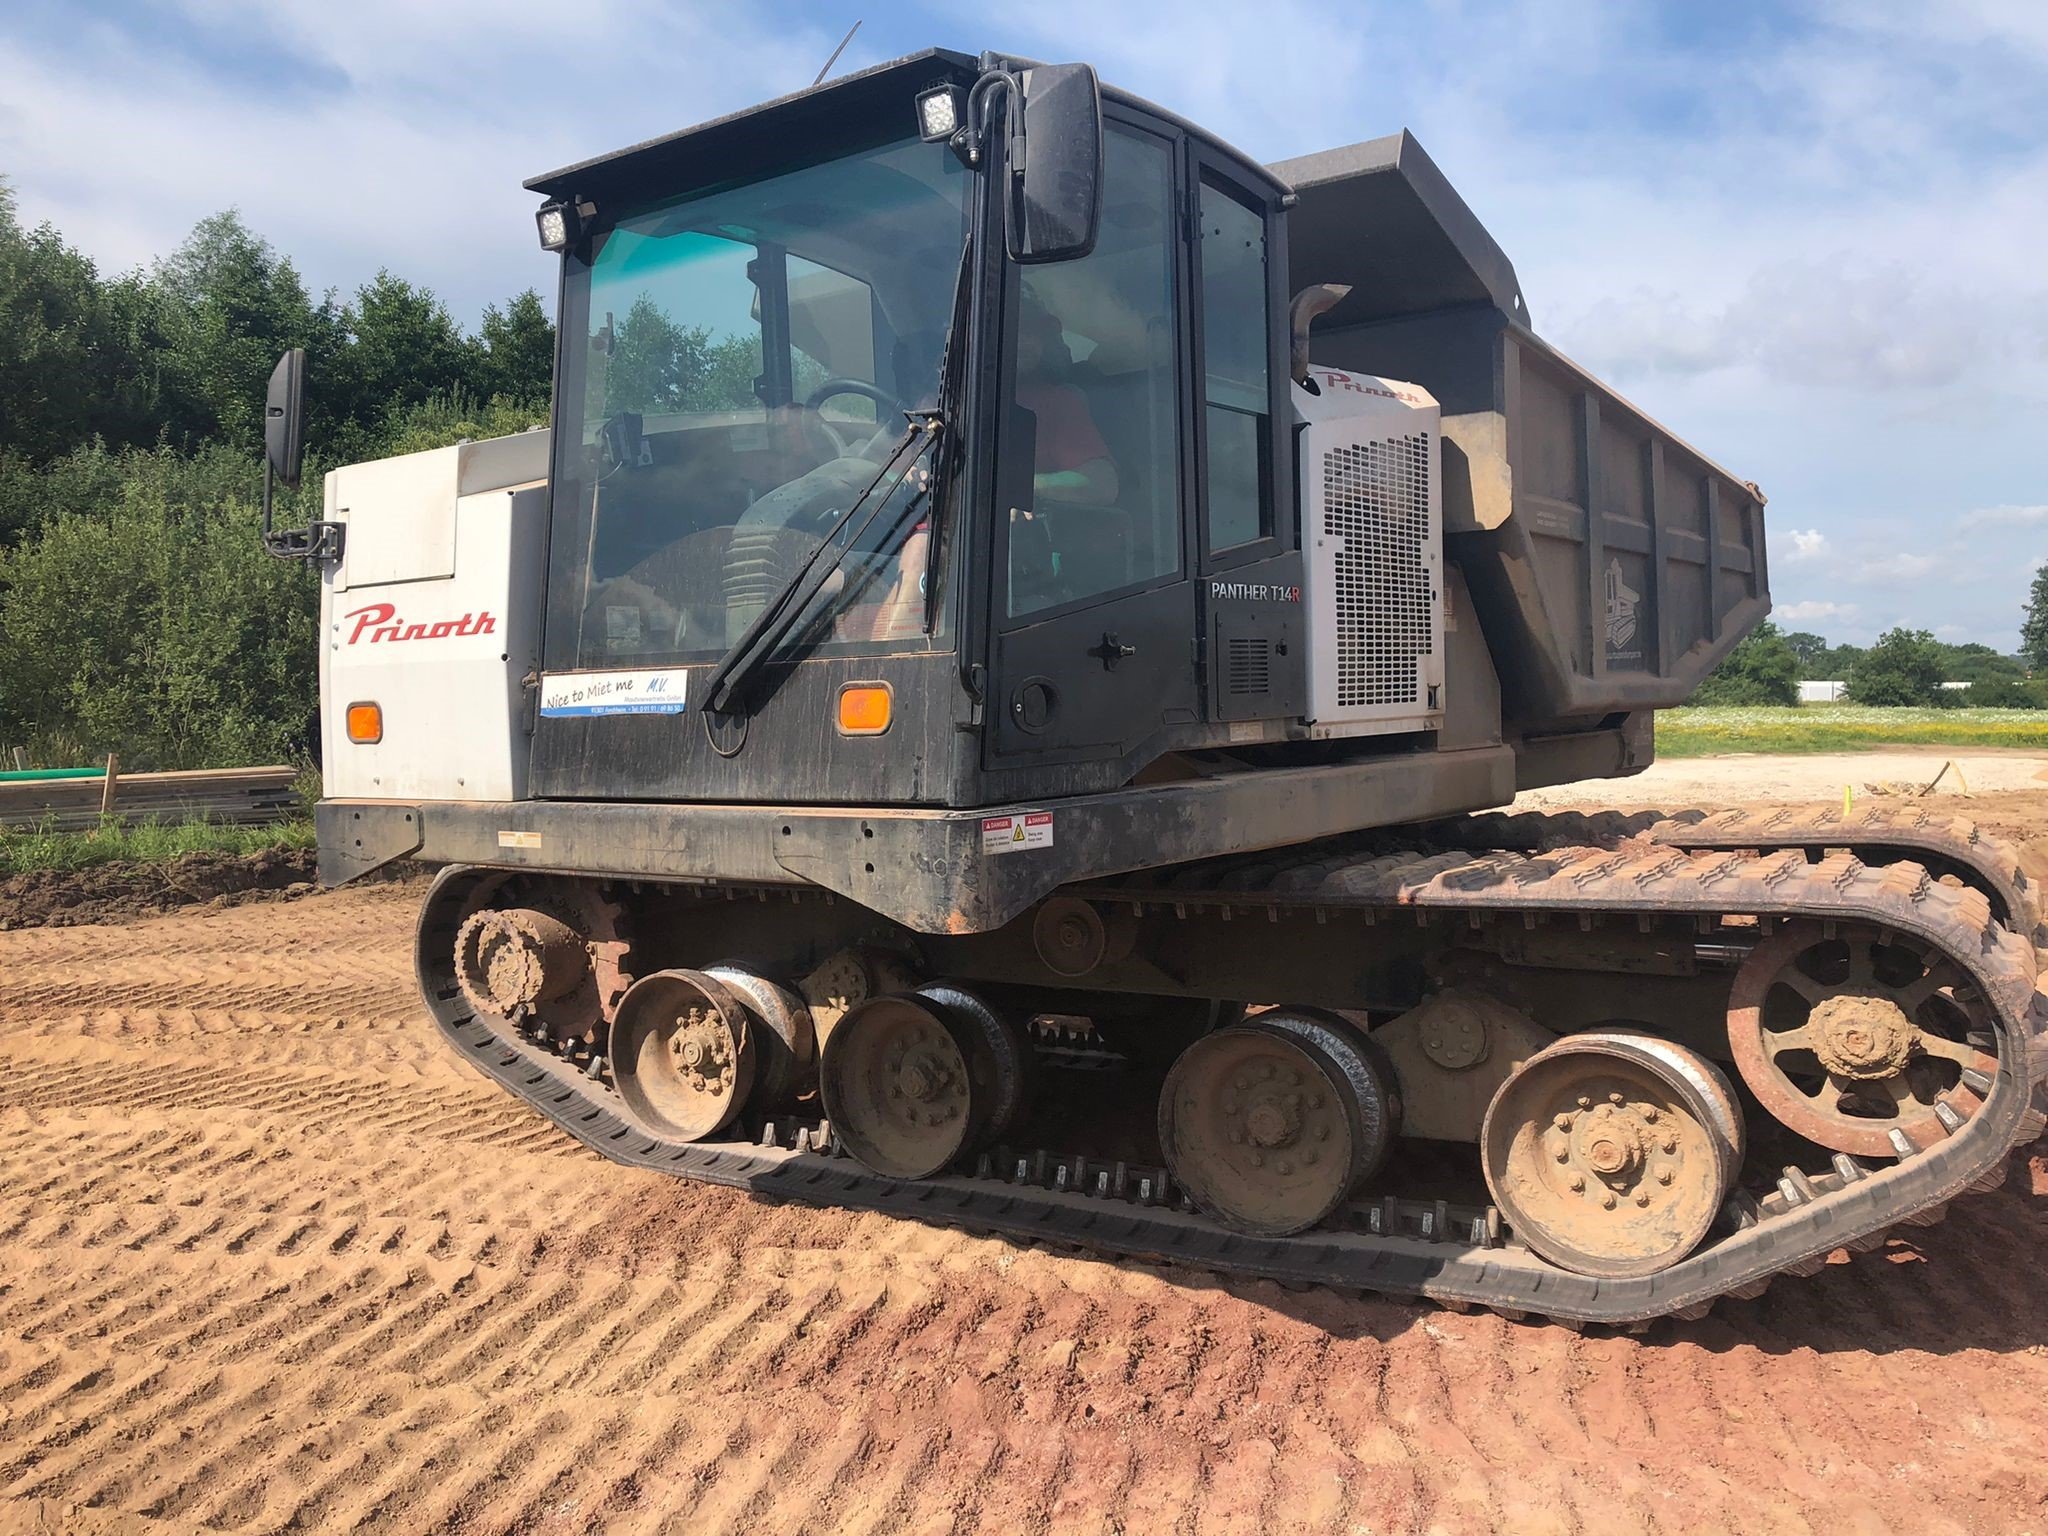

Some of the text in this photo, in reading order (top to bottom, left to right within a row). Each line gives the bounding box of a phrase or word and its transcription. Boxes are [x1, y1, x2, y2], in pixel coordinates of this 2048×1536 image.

[1315, 371, 1421, 403] Prinoth
[1211, 582, 1300, 602] PANTHER T14R
[344, 603, 497, 645] Prinoth
[546, 679, 634, 710] Nice to Miet me
